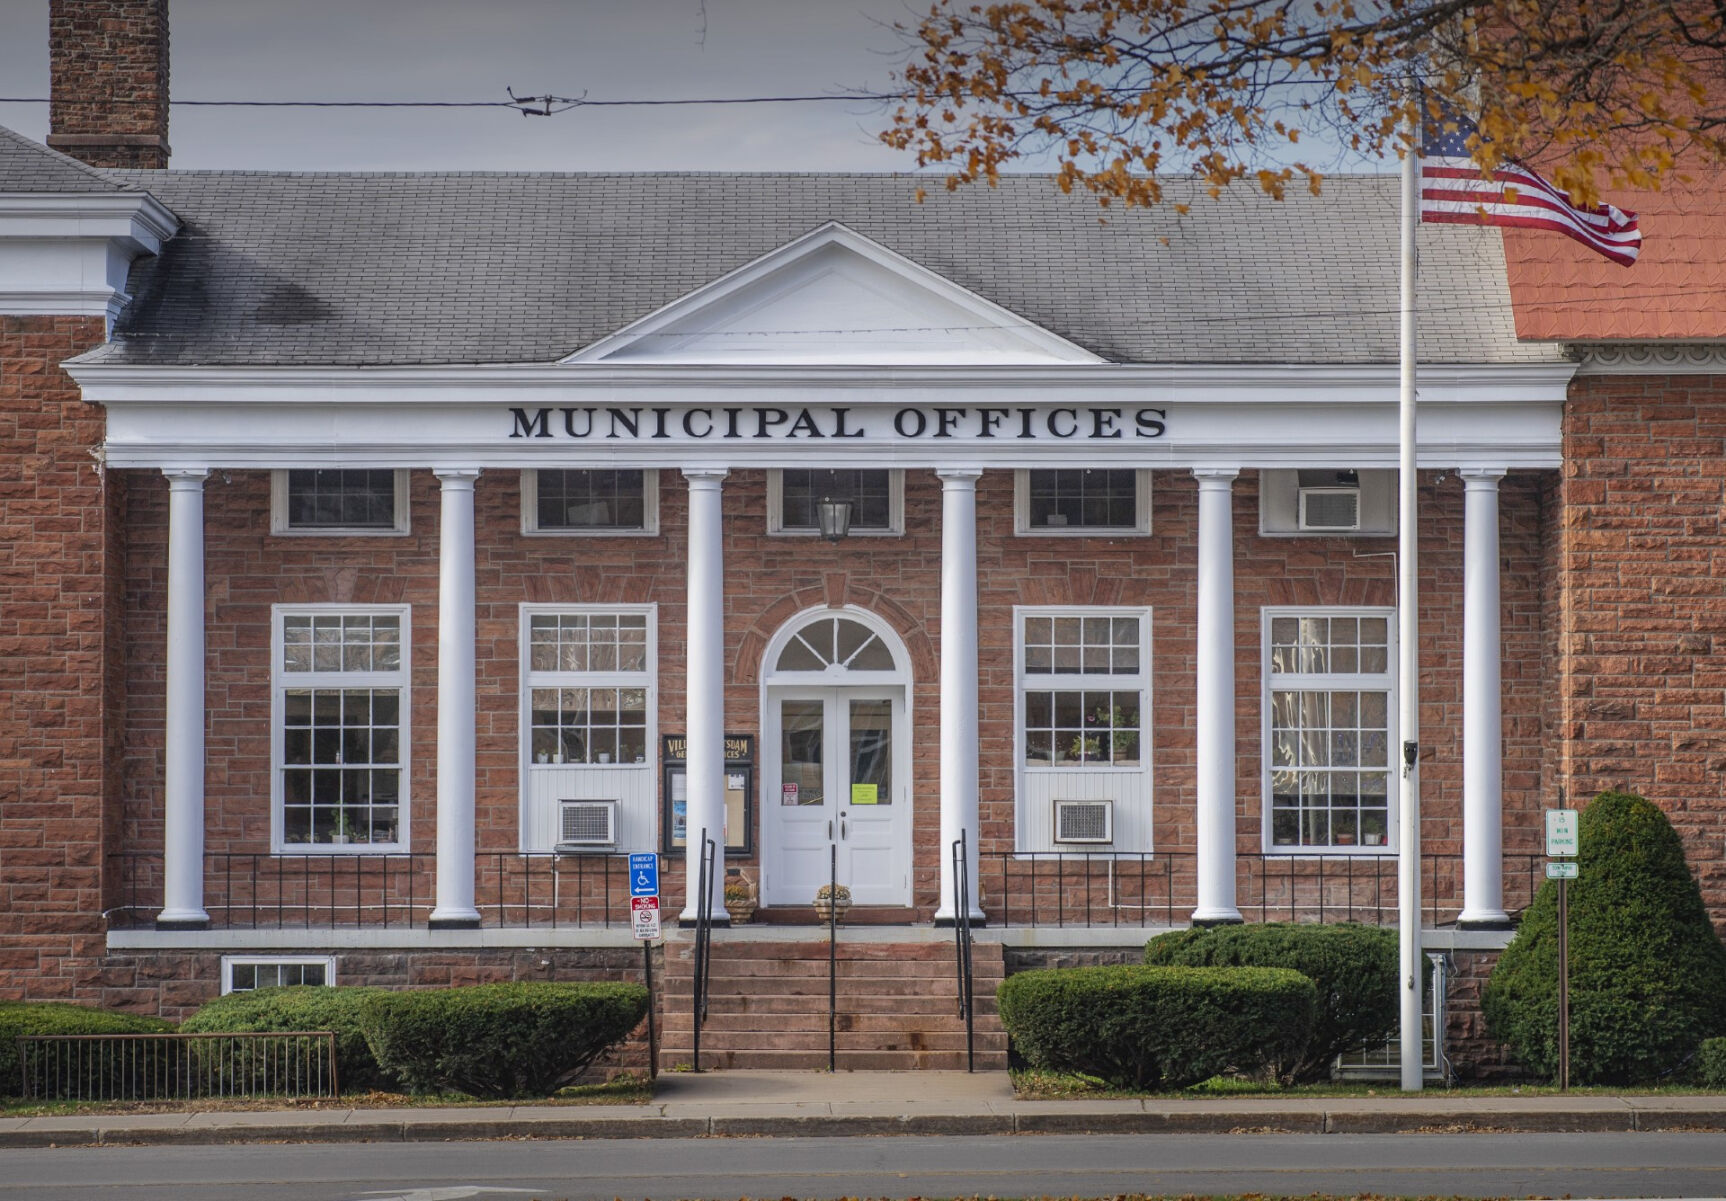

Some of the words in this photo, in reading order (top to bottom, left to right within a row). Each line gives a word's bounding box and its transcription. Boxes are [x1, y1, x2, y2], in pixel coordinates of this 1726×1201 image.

[508, 407, 865, 438] MUNICIPAL
[895, 407, 1167, 438] OFFICES
[668, 739, 687, 753] VILL
